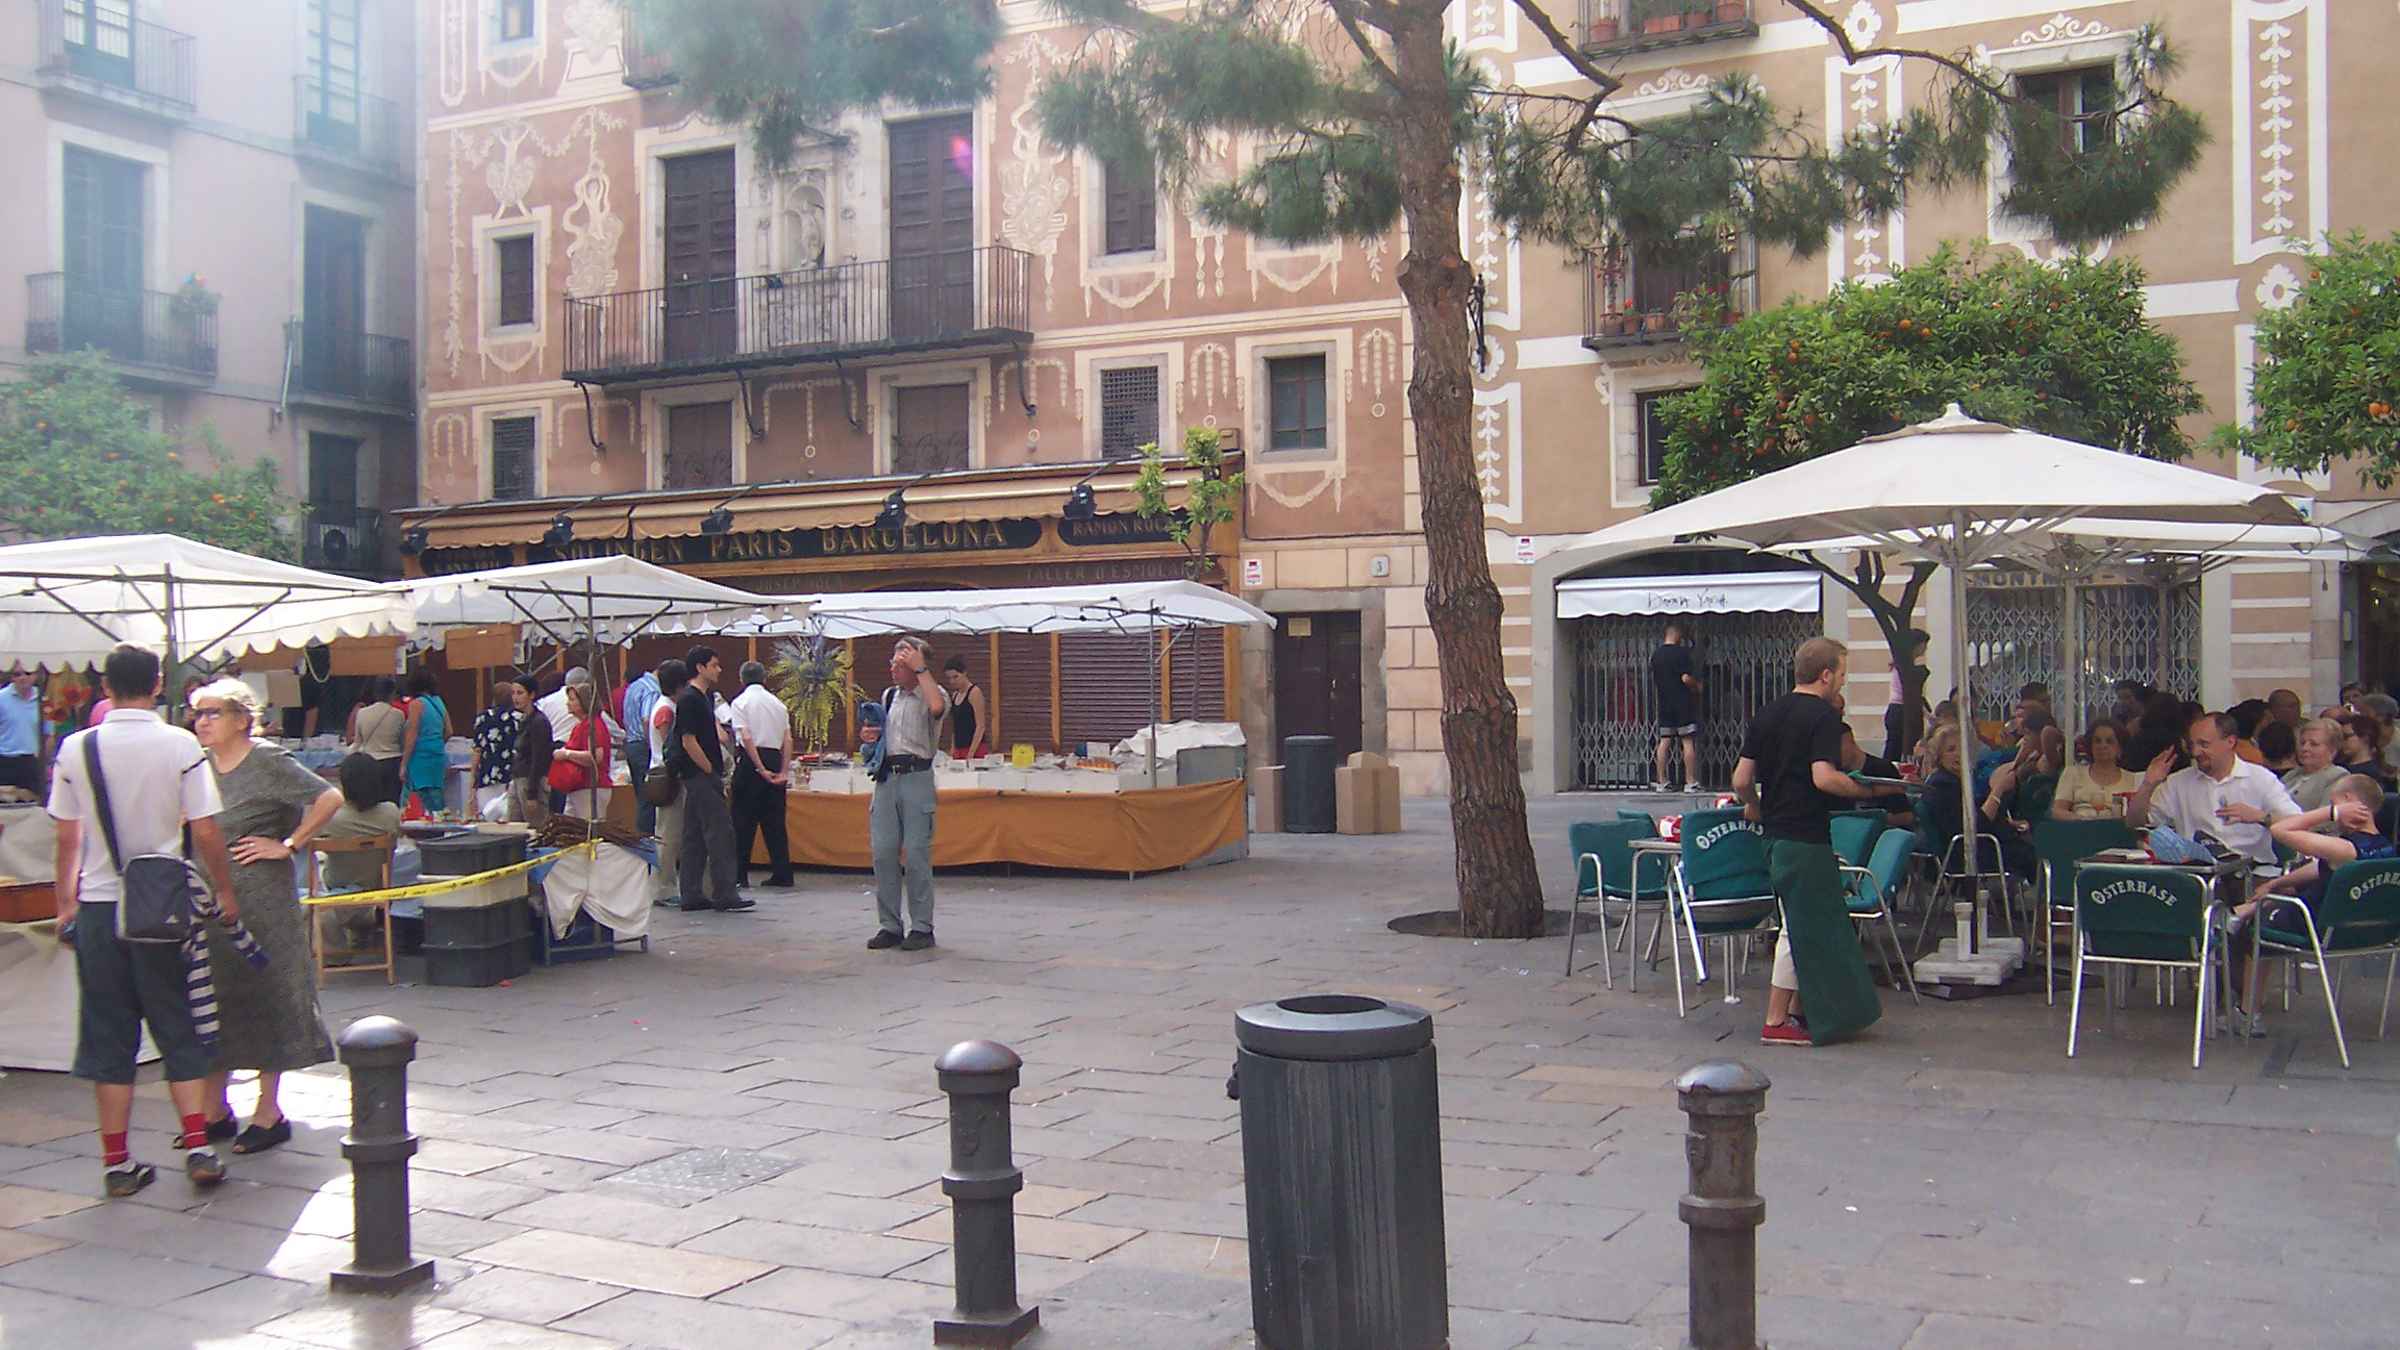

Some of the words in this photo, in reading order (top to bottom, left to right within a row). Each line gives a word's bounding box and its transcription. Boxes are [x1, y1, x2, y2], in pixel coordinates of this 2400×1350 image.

[1071, 518, 1131, 537] RAMON
[709, 532, 793, 559] PARIS
[2090, 880, 2178, 907] OSTERHASE
